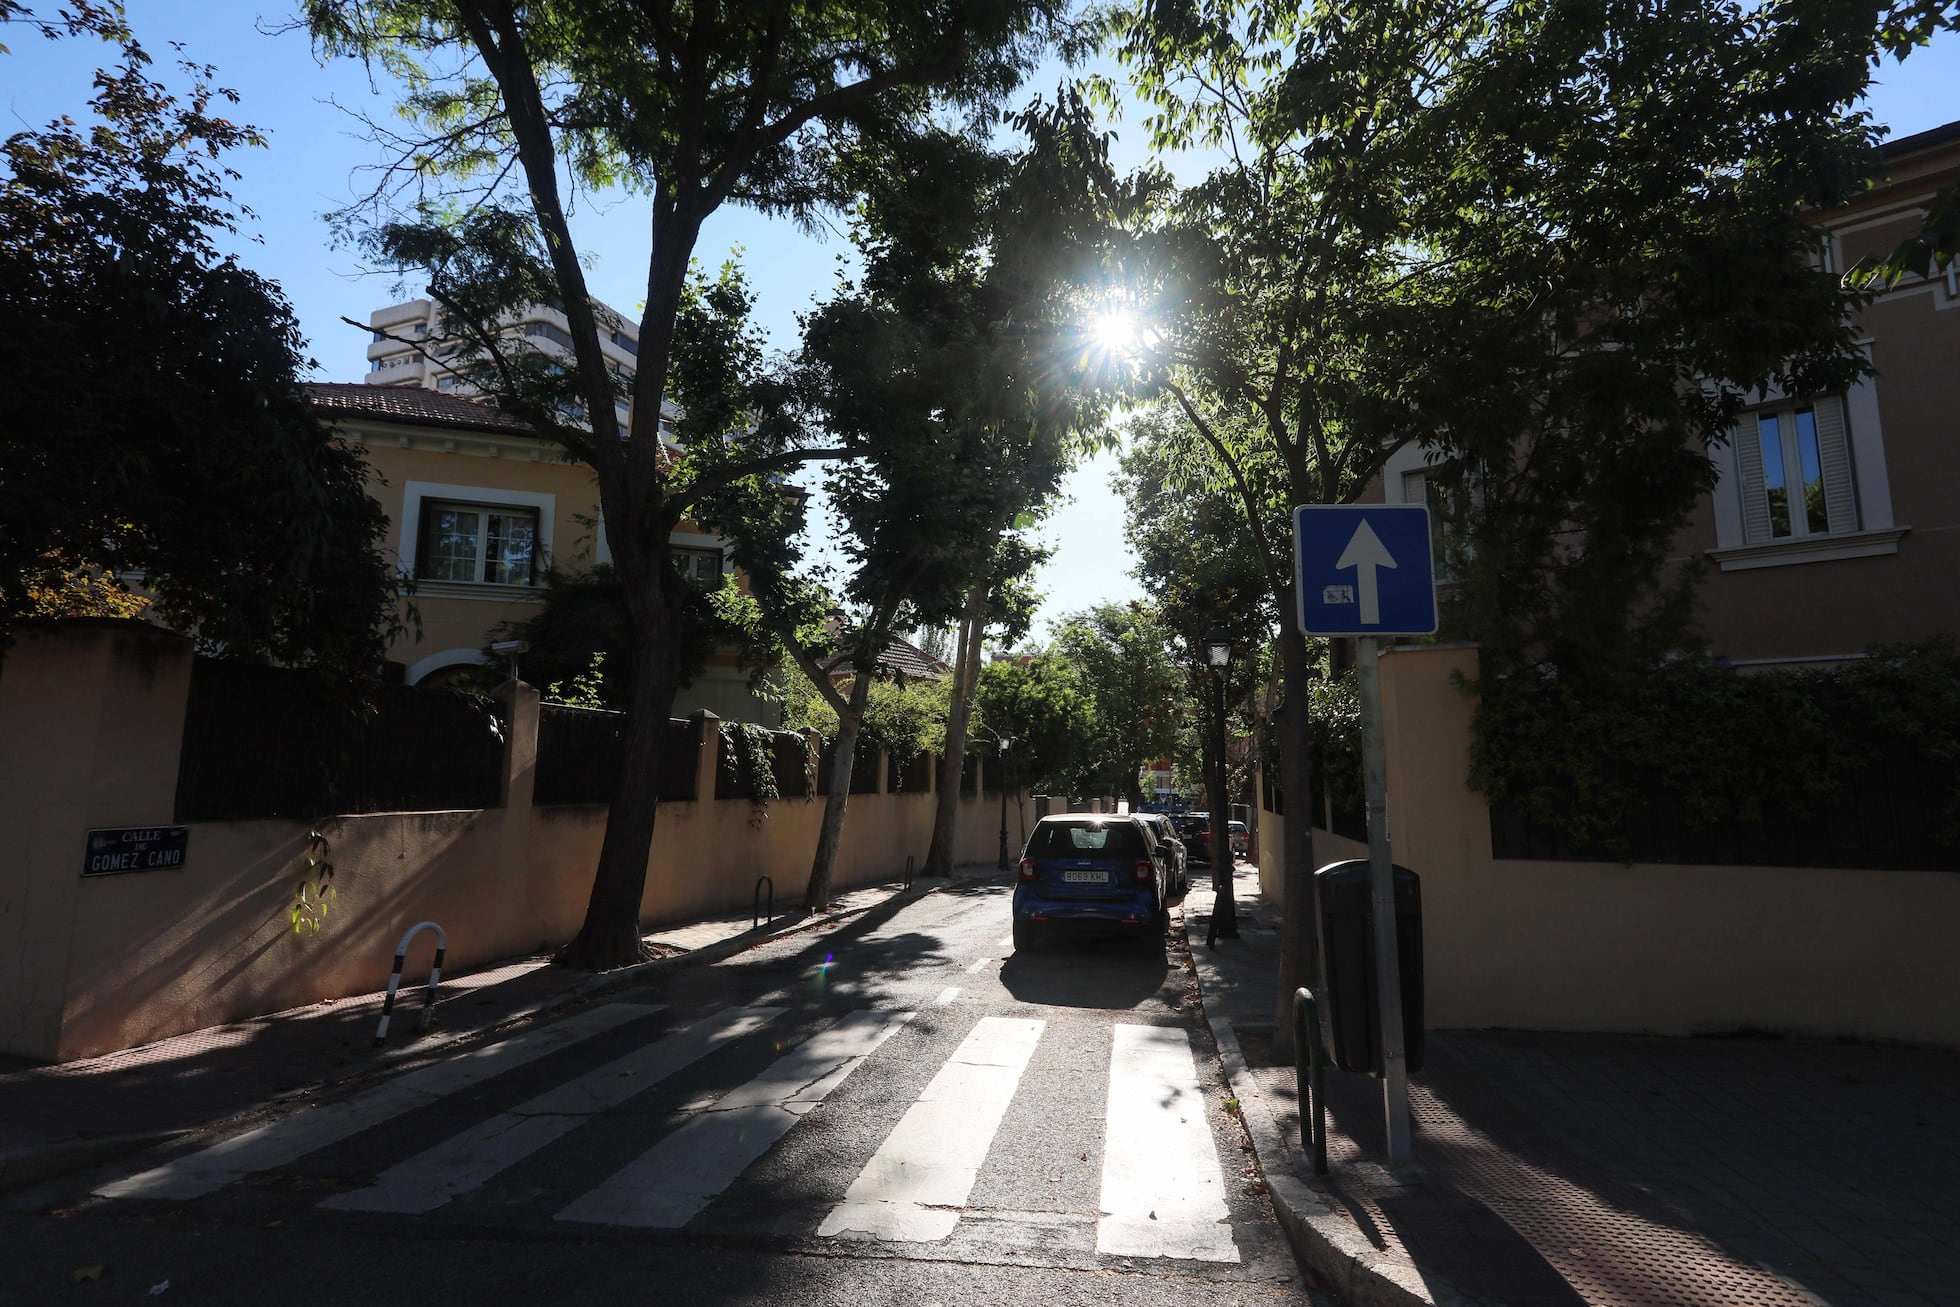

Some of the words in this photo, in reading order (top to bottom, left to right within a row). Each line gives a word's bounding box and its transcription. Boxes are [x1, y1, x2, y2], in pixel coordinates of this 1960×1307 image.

[121, 830, 161, 842] CALLE
[134, 842, 148, 851] DE
[91, 852, 140, 872] GOMEZ
[148, 849, 181, 866] CANO
